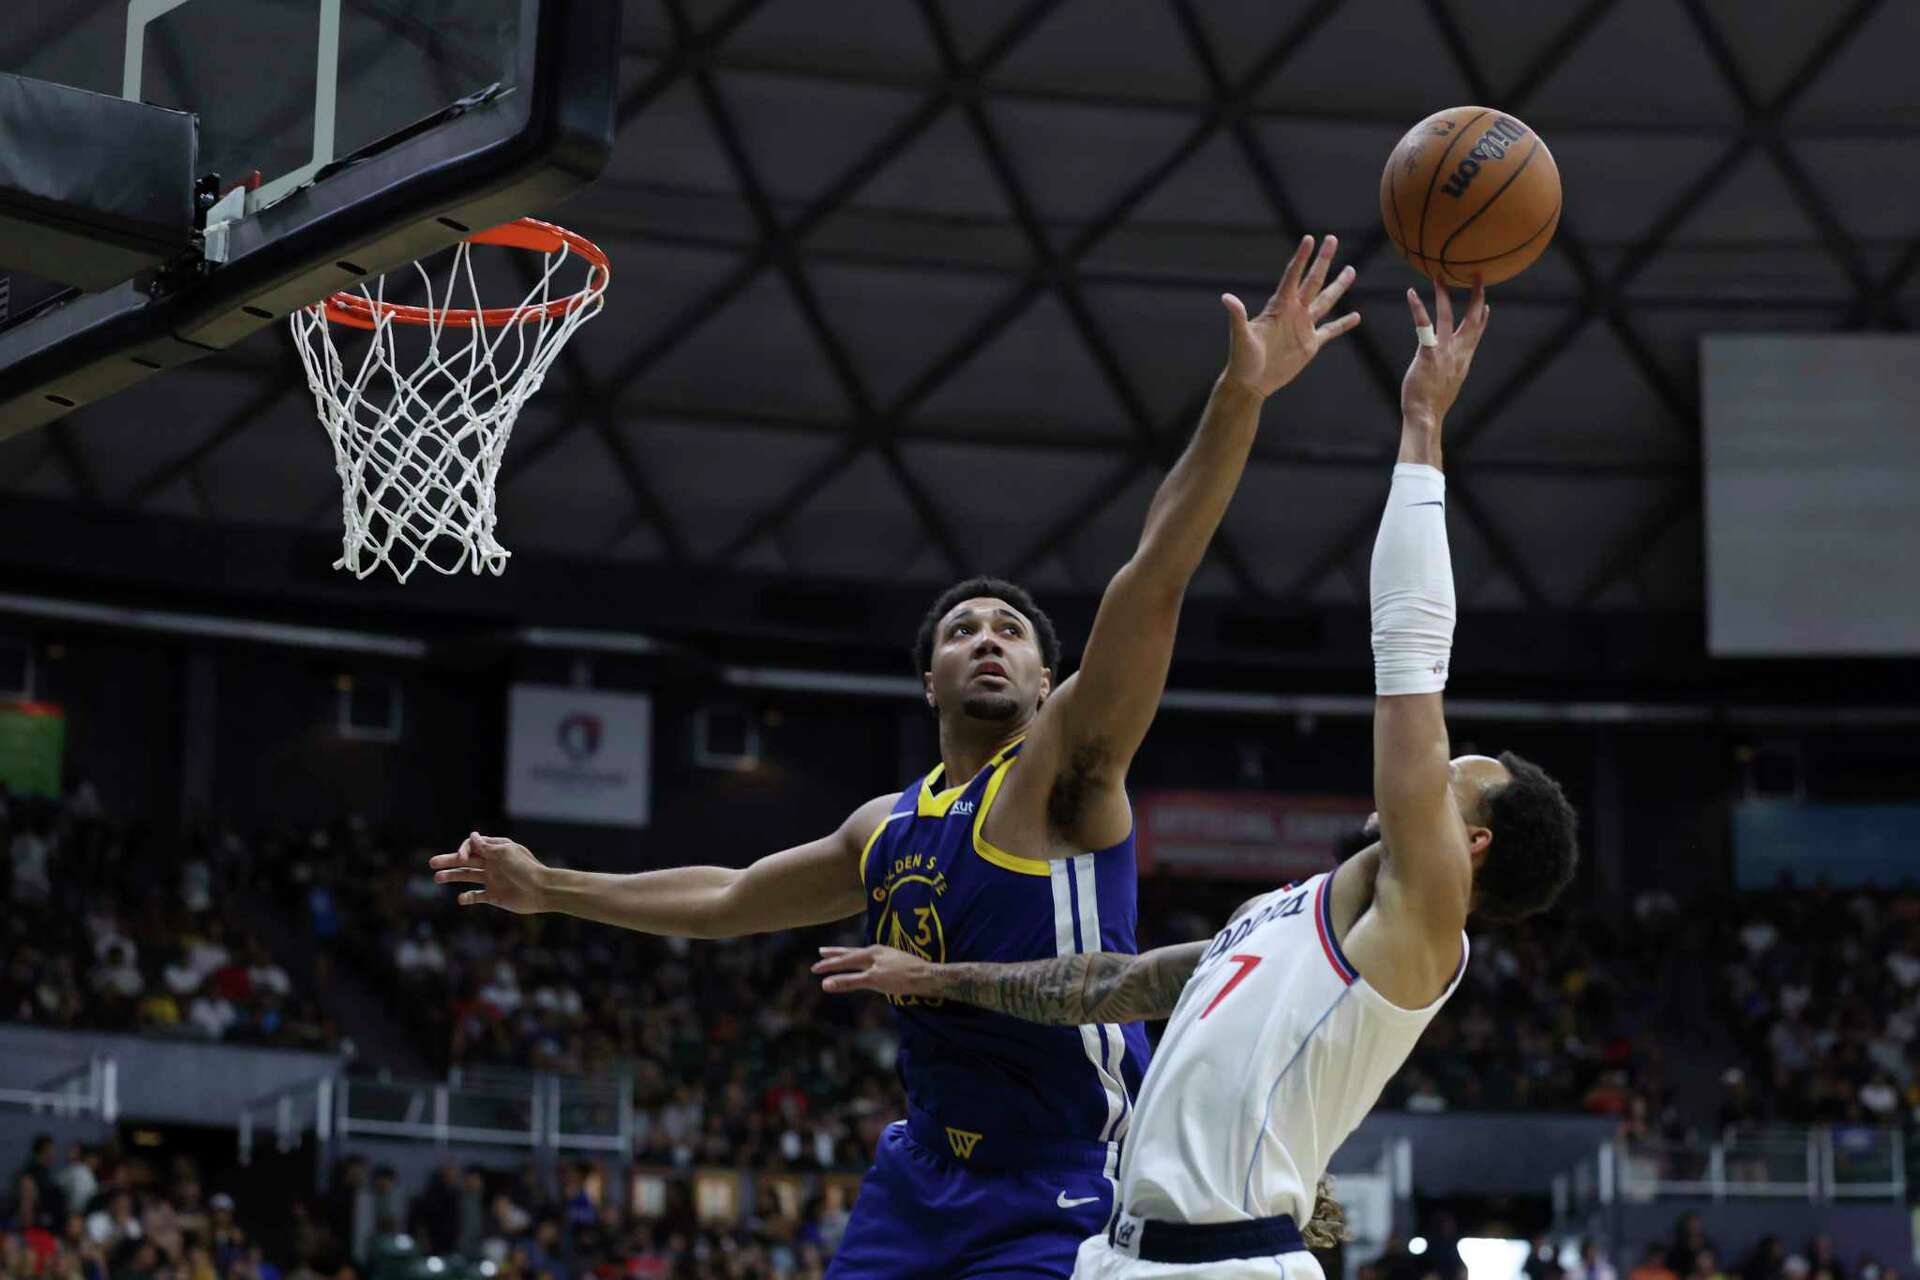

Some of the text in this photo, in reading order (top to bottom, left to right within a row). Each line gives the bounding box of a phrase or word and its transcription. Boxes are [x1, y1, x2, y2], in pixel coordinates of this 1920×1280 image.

[1440, 115, 1526, 198] Wilson
[913, 907, 932, 946] 3
[1200, 954, 1263, 1020] 7
